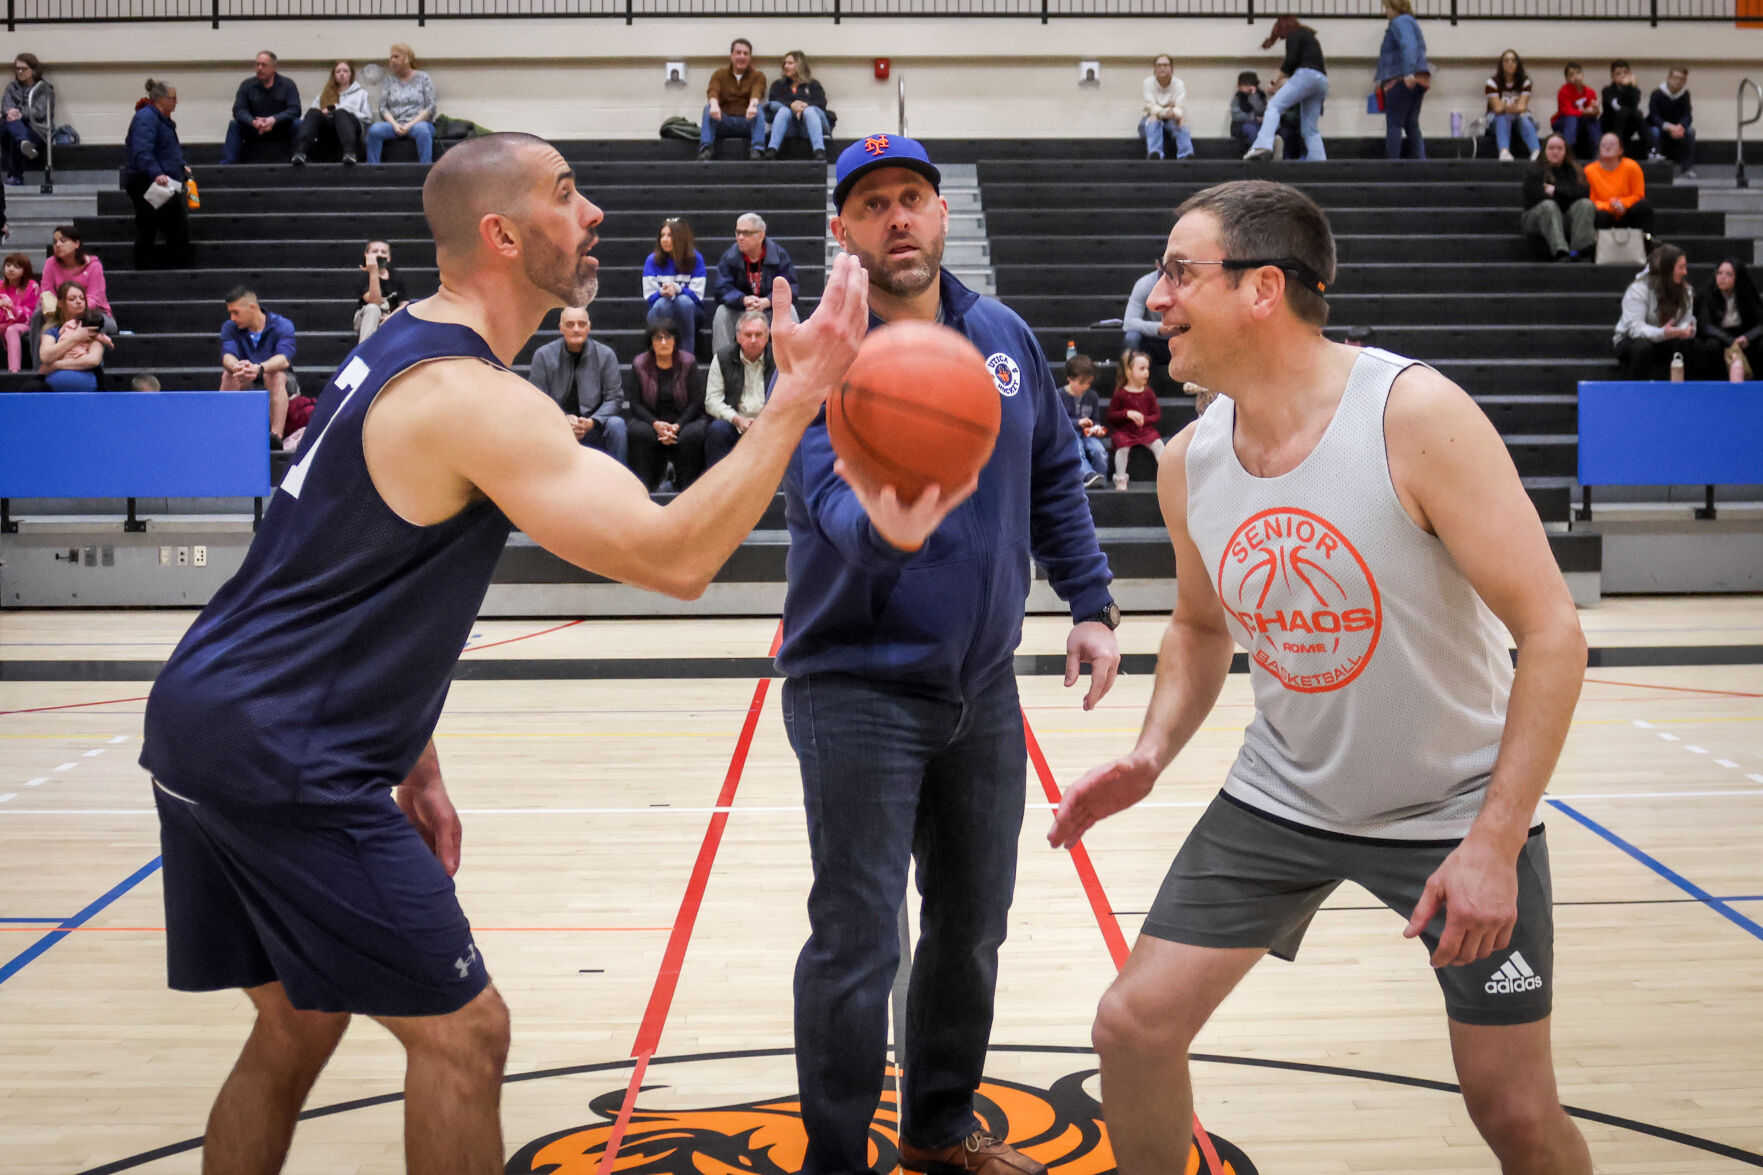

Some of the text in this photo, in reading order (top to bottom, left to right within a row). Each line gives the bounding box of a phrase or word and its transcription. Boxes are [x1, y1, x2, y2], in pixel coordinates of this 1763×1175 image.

[988, 355, 1008, 368] UTICA
[998, 379, 1018, 394] HOCKEY
[280, 356, 371, 500] 7
[1231, 517, 1338, 563] SENIOR
[1237, 607, 1375, 634] CHAOS
[1283, 642, 1326, 654] ROME
[1255, 649, 1364, 687] BASKETBALL
[1484, 975, 1543, 994] adidas
